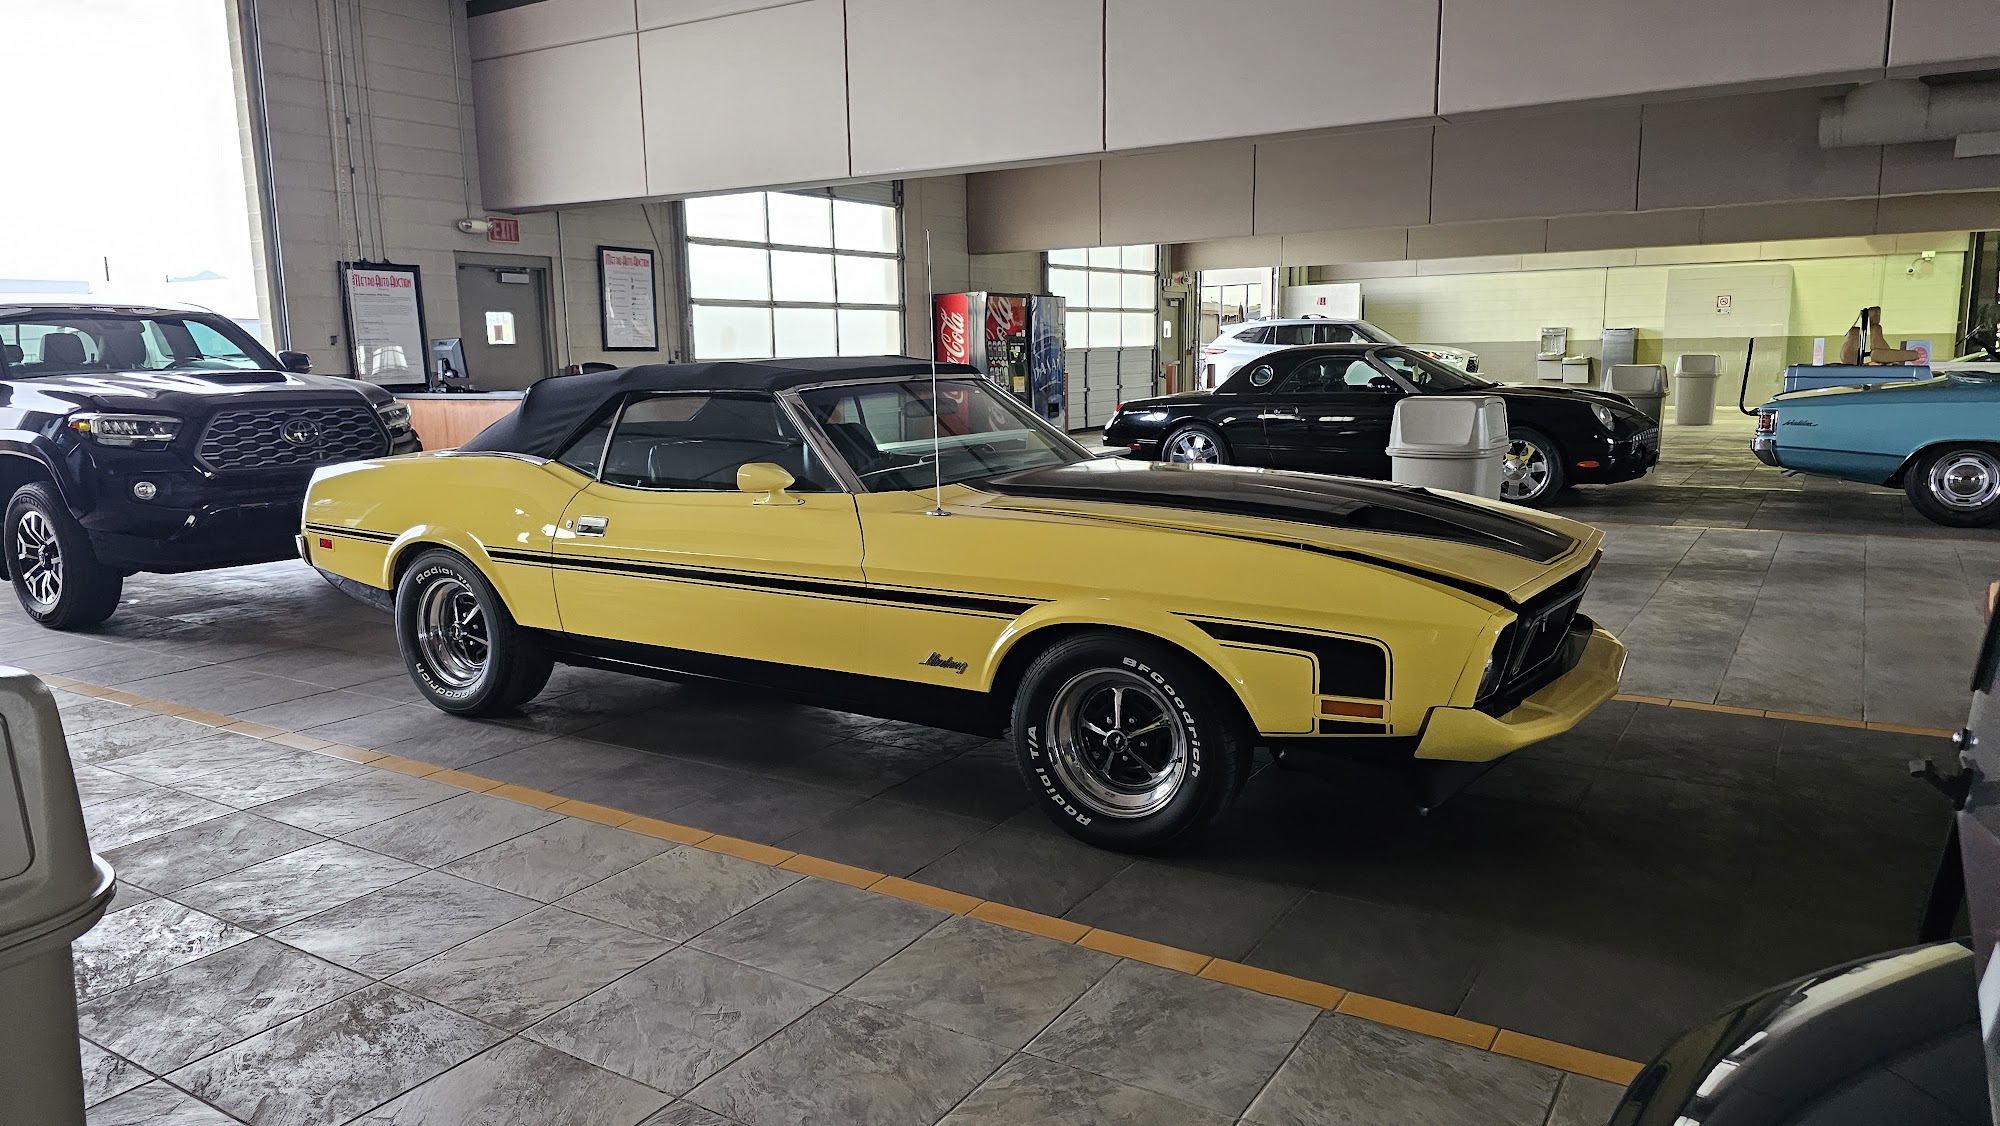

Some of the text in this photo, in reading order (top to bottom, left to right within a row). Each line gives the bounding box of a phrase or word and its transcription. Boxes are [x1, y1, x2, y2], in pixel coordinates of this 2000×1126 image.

[492, 220, 516, 241] EXIT
[353, 273, 375, 287] METRO
[375, 274, 390, 288] AUTO
[415, 566, 454, 585] Radial
[1122, 656, 1201, 778] BFGoodrich
[1027, 725, 1092, 827] Radial T/A
